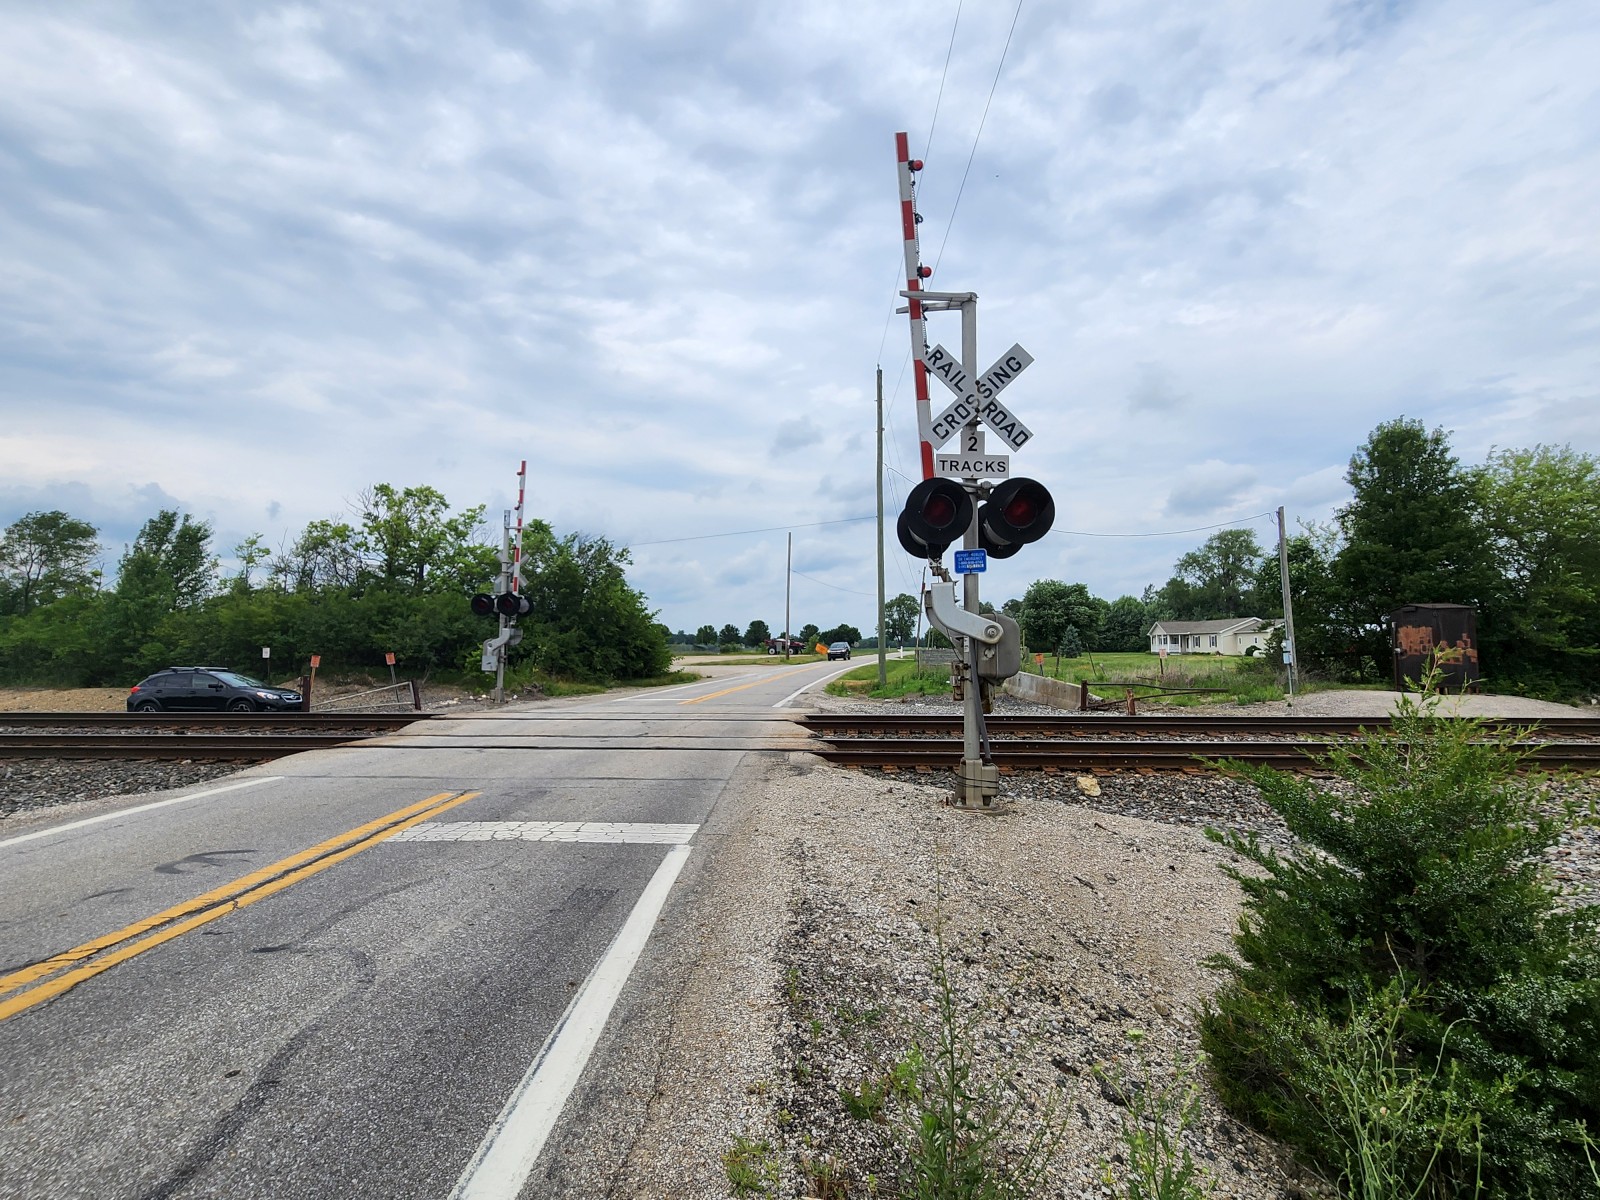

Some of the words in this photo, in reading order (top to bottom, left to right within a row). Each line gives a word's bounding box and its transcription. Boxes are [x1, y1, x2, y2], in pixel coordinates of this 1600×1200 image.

[932, 356, 1022, 440] CROSSING
[967, 436, 978, 452] 2
[938, 459, 1007, 473] TRACKS
